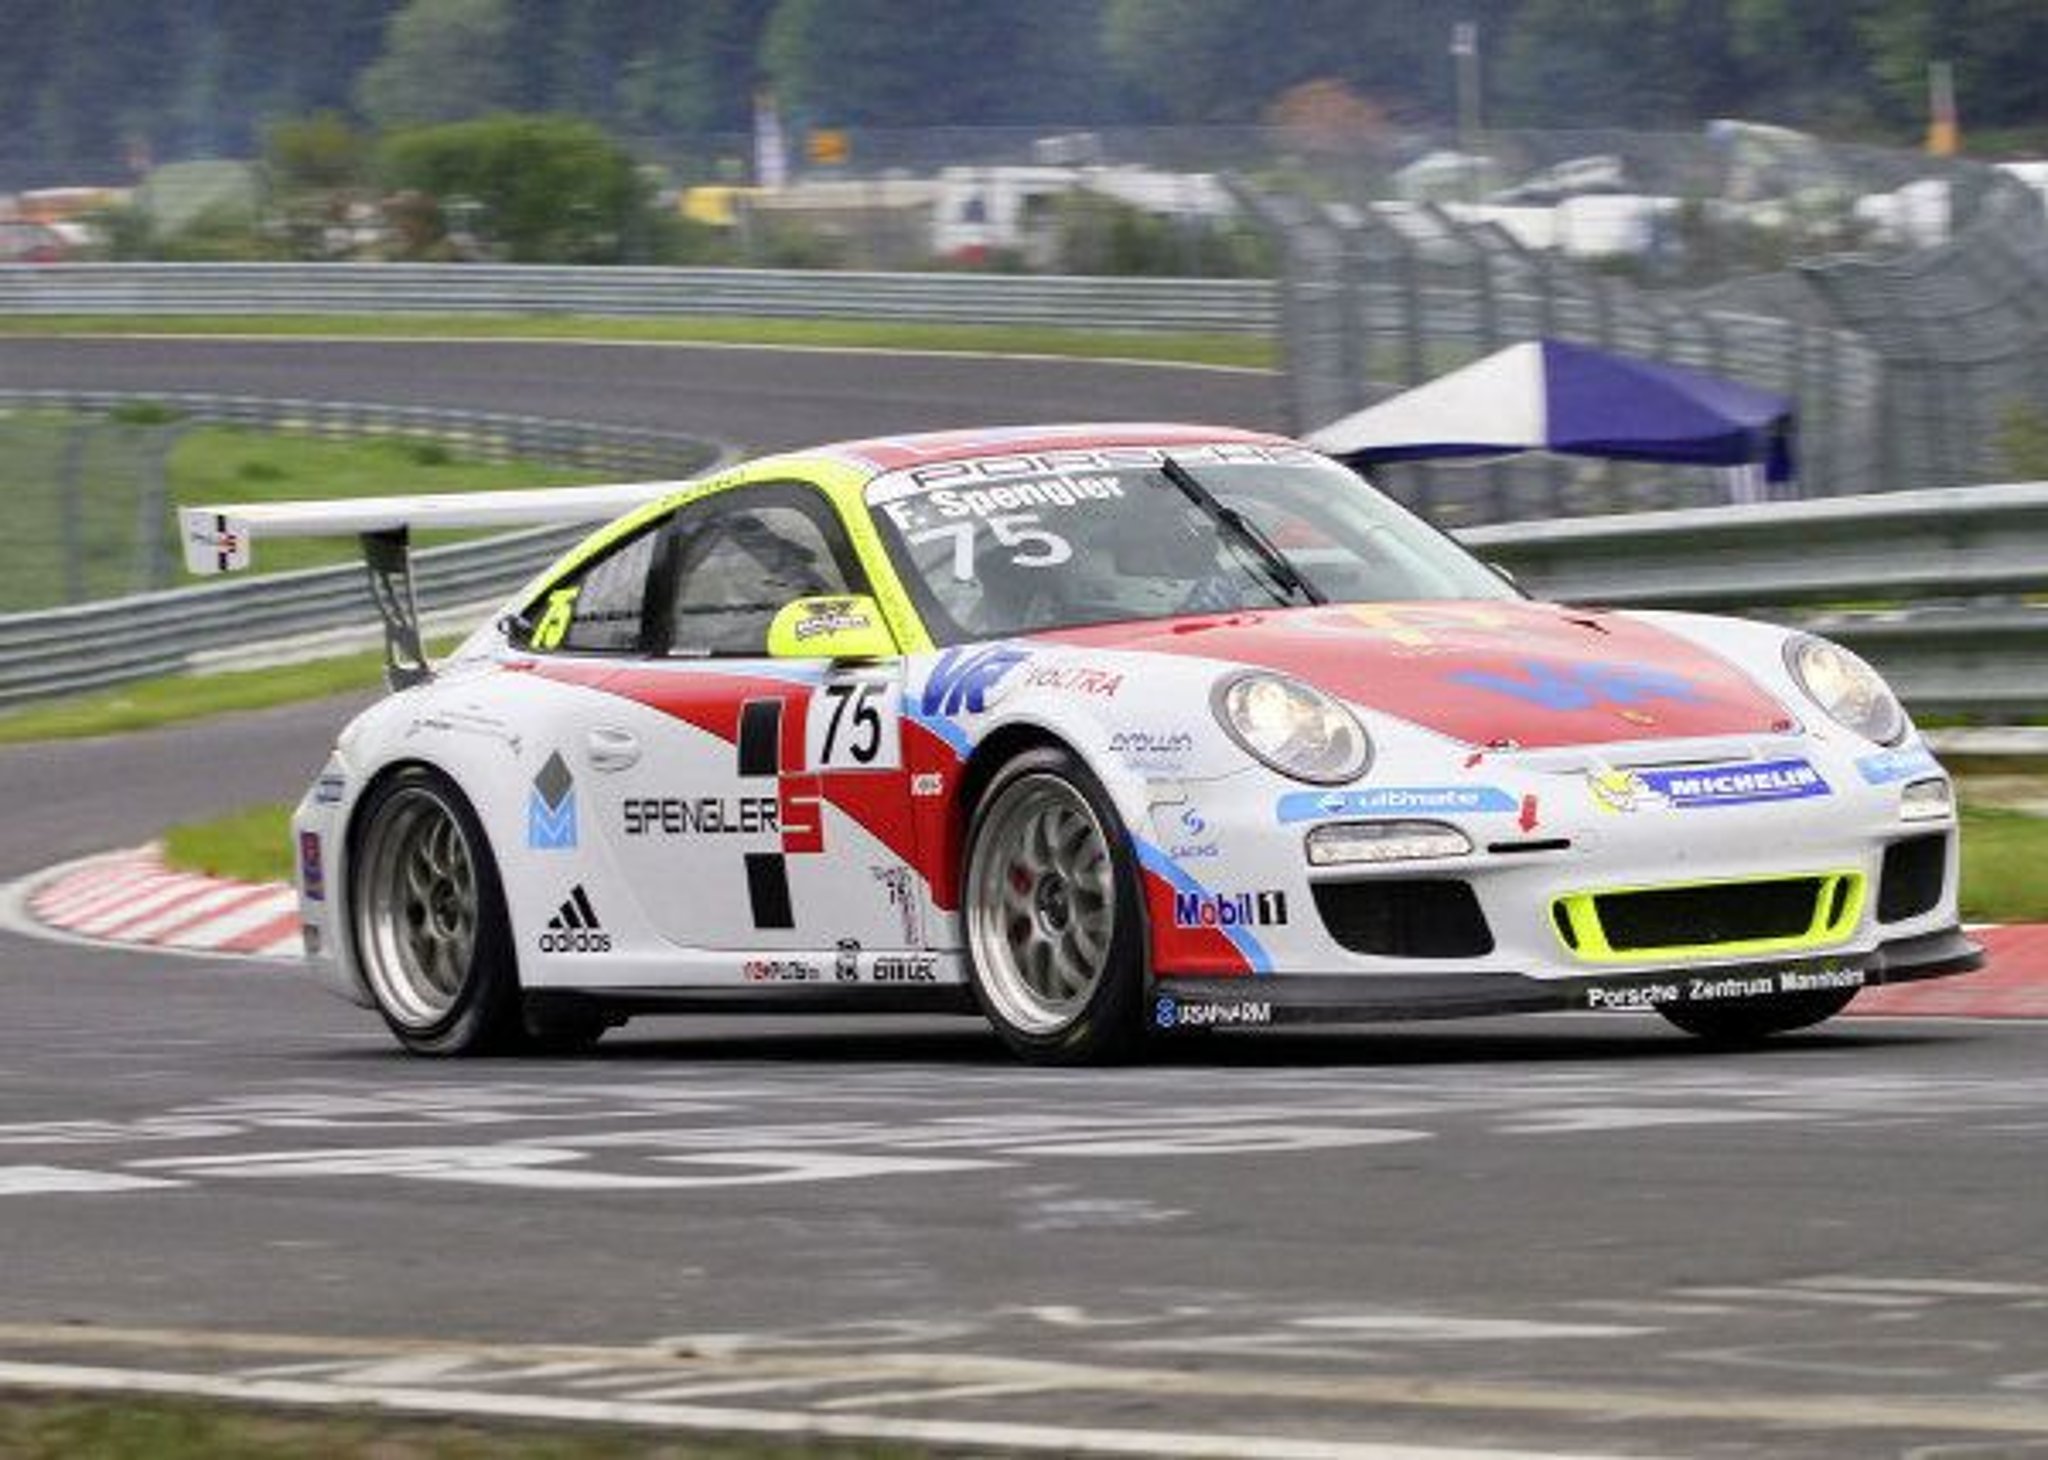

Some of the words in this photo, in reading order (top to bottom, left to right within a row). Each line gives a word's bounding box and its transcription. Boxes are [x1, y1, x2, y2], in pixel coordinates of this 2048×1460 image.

[928, 476, 1125, 517] Spengler
[908, 513, 1073, 581] 75
[821, 684, 886, 764] 75
[1669, 766, 1819, 796] MICHELIN
[624, 798, 779, 833] SPENGLER
[1176, 893, 1253, 925] Mobil
[539, 927, 612, 953] adidas
[1587, 983, 1679, 1009] Porsche
[1689, 975, 1773, 1000] Zentrum
